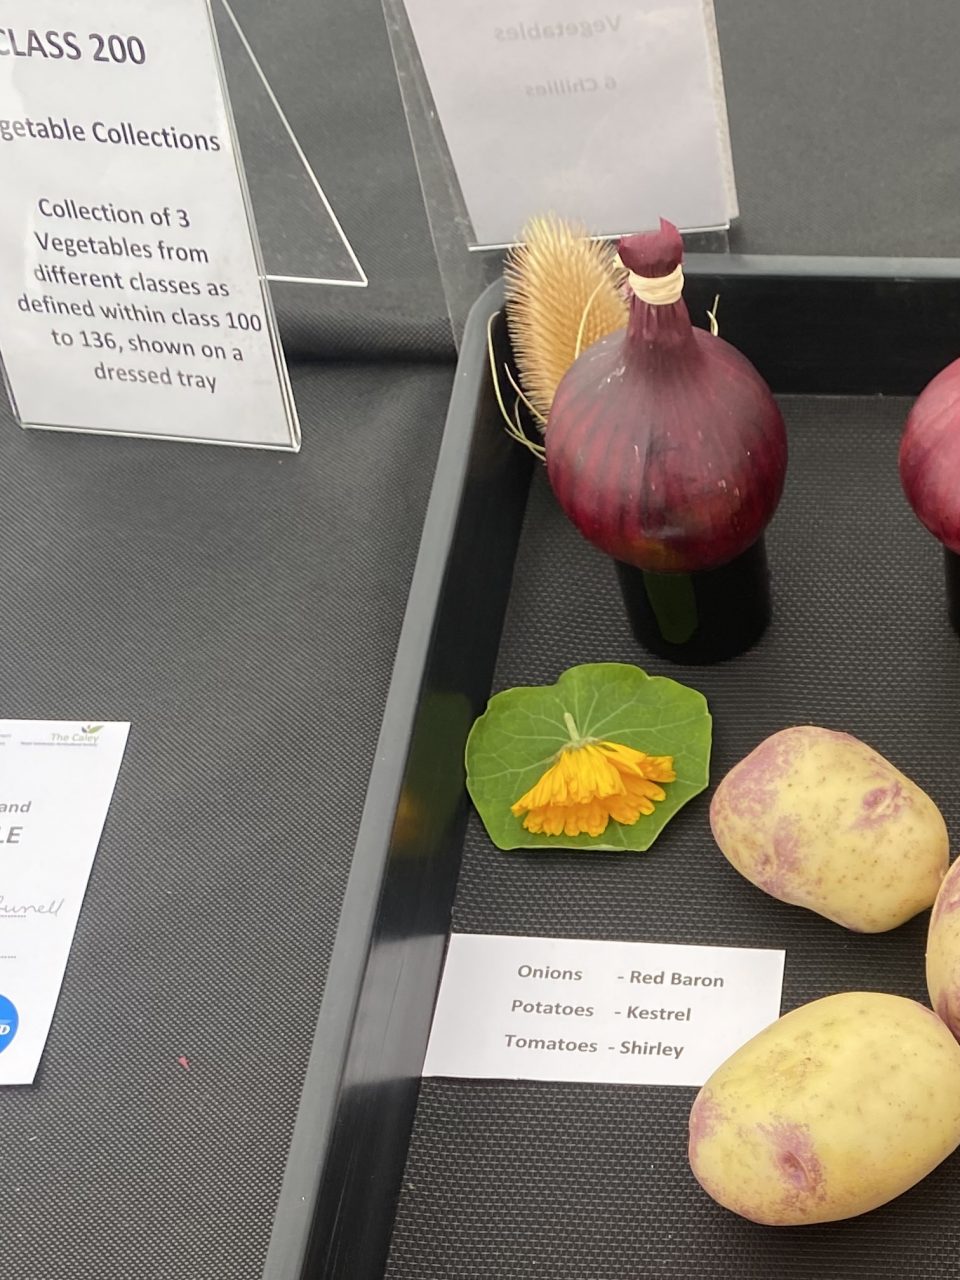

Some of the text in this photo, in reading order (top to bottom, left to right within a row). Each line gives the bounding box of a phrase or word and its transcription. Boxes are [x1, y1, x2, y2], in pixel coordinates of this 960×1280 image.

[89, 33, 146, 65] 200
[92, 122, 220, 151] Collections
[38, 198, 190, 228] Collection of 3
[34, 231, 208, 263] Vegetables from
[34, 264, 229, 297] different classes as
[18, 294, 262, 331] defined within class 100
[51, 329, 244, 361] to 136, shown on a
[94, 362, 217, 394] dressed tray
[0, 800, 32, 813] and
[517, 964, 583, 981] Onions
[630, 970, 665, 985] Red
[670, 972, 724, 987] Baron
[511, 999, 594, 1017] Potatoes
[627, 1005, 691, 1021] Kestrel
[505, 1034, 598, 1052] Tomatoes
[620, 1041, 684, 1059] Shirley
